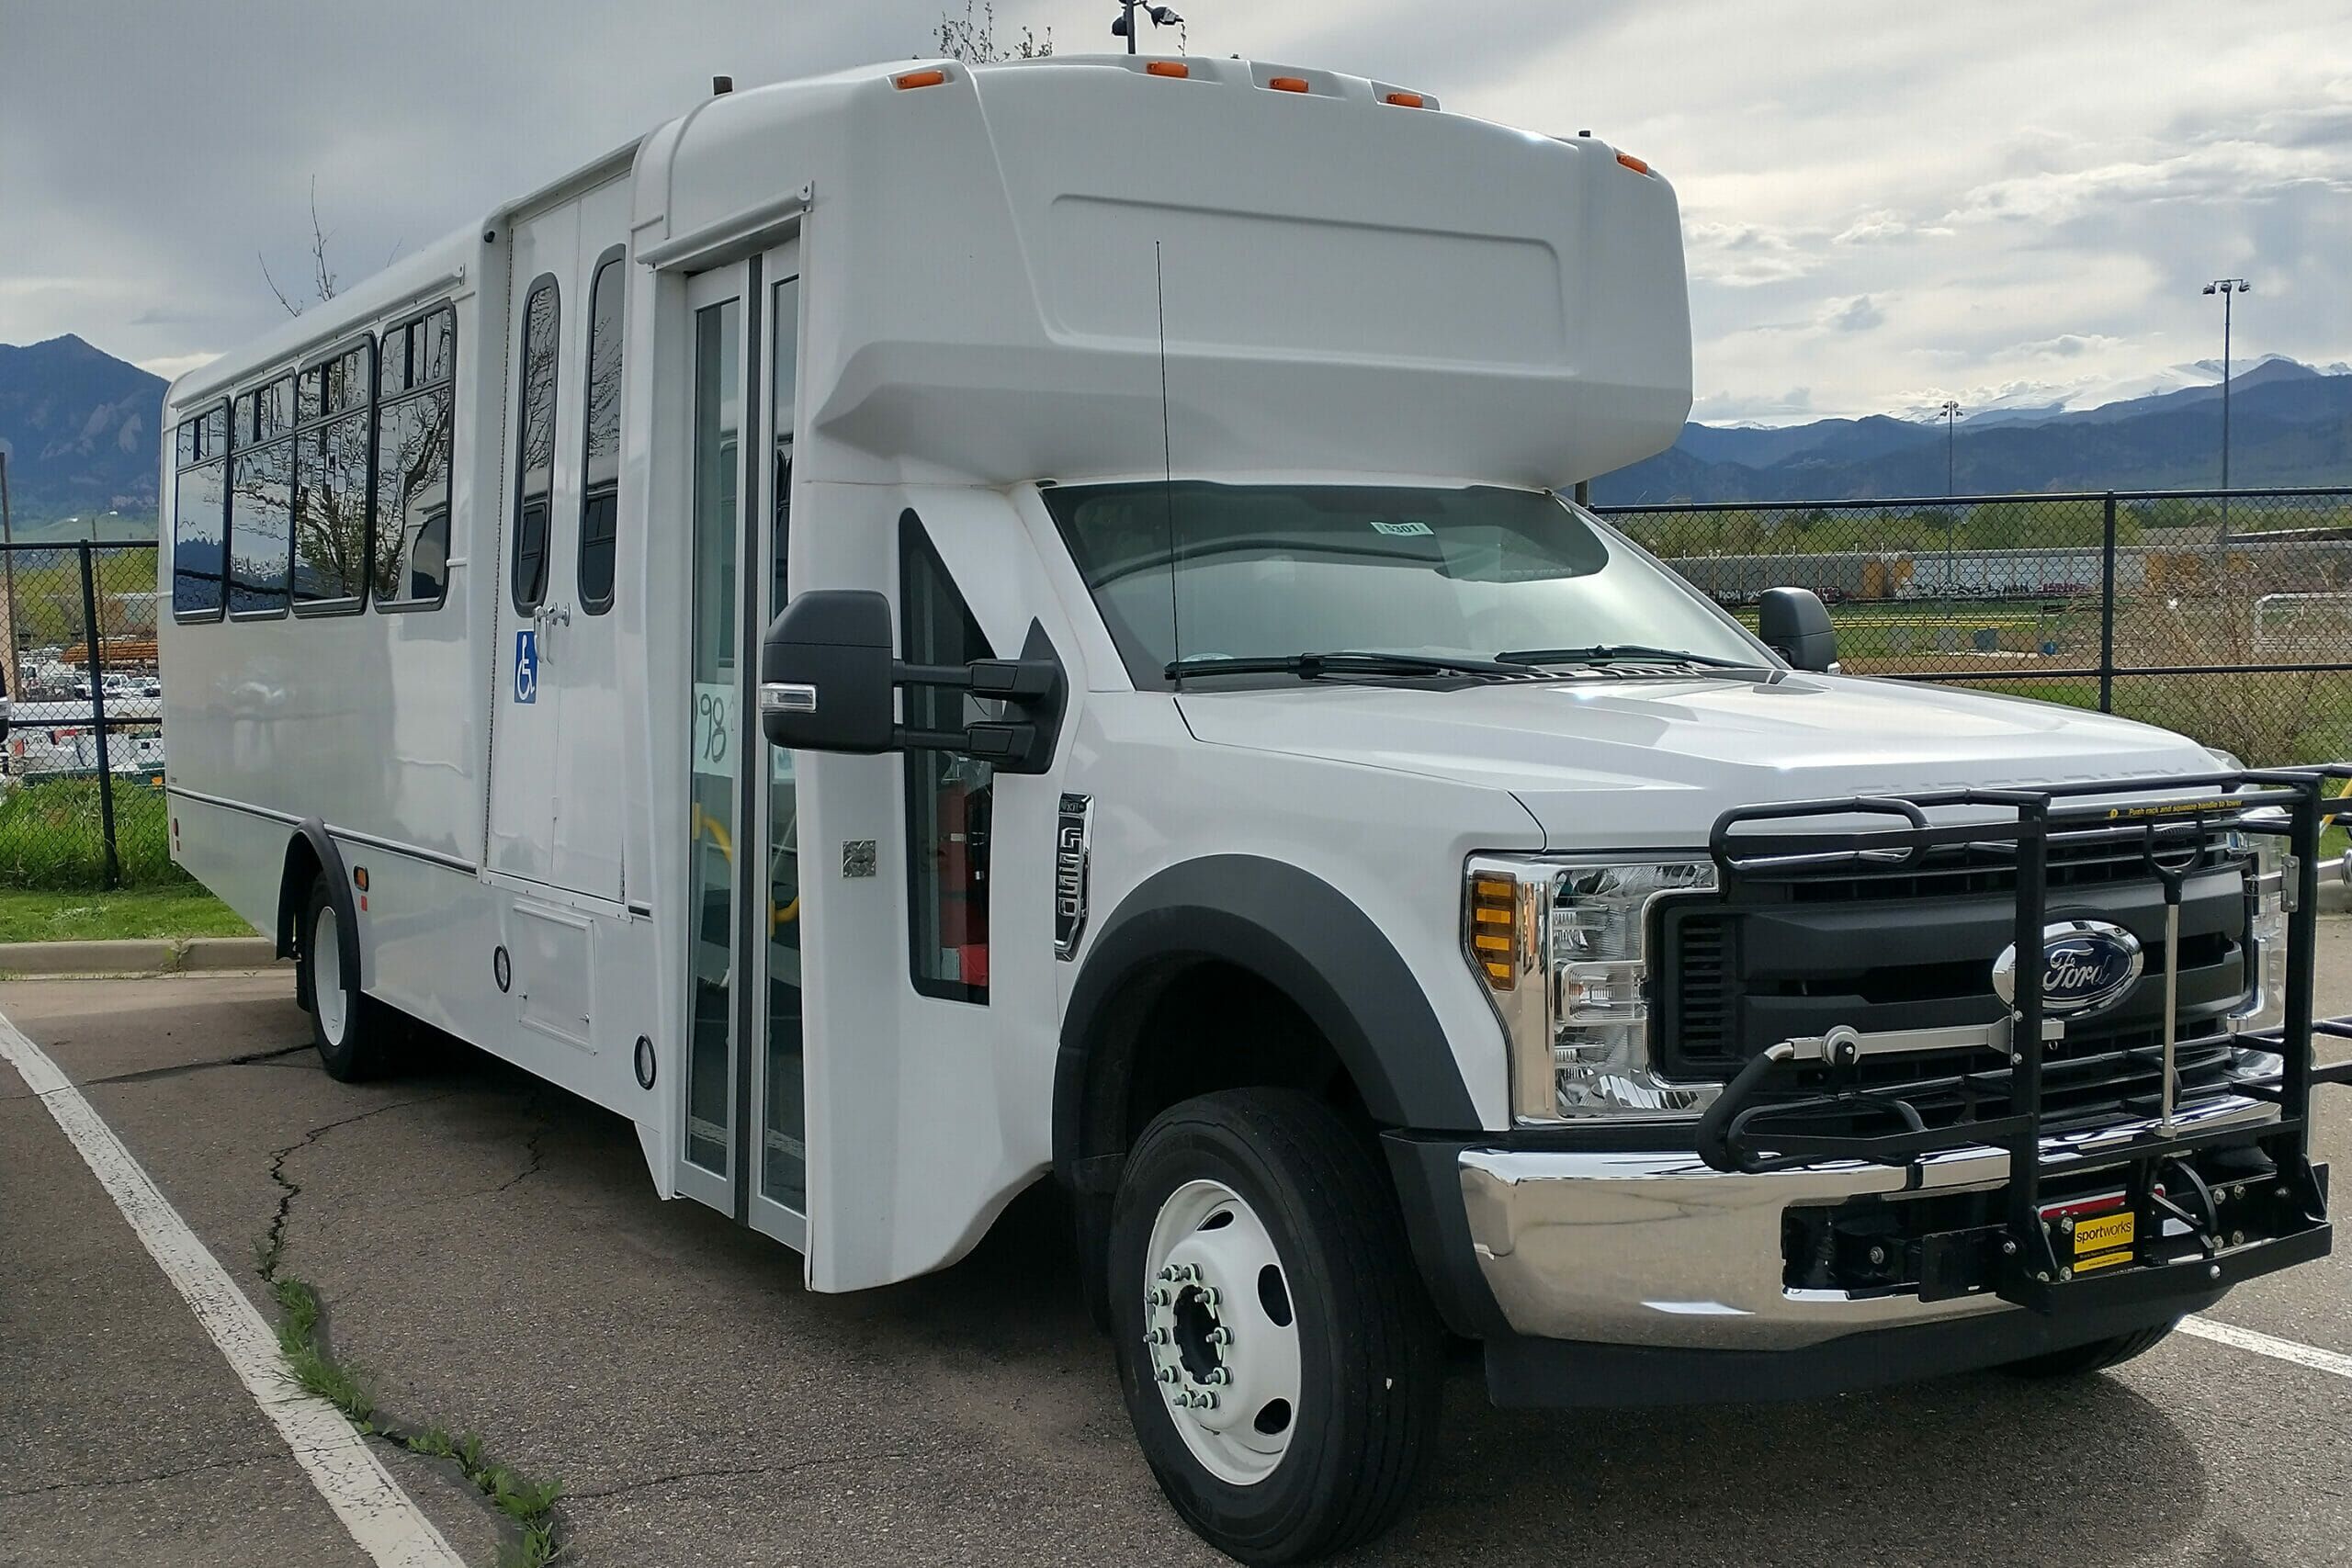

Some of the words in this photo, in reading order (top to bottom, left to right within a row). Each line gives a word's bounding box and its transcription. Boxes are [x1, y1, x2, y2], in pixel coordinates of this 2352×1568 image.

[2129, 807, 2144, 817] Push
[2145, 806, 2158, 815] rack
[2159, 805, 2172, 813] and
[2199, 801, 2218, 810] handle
[2219, 800, 2226, 808] to
[2227, 799, 2242, 808] lower
[2042, 948, 2111, 991] Ford
[2075, 1221, 2132, 1243] sportworks
